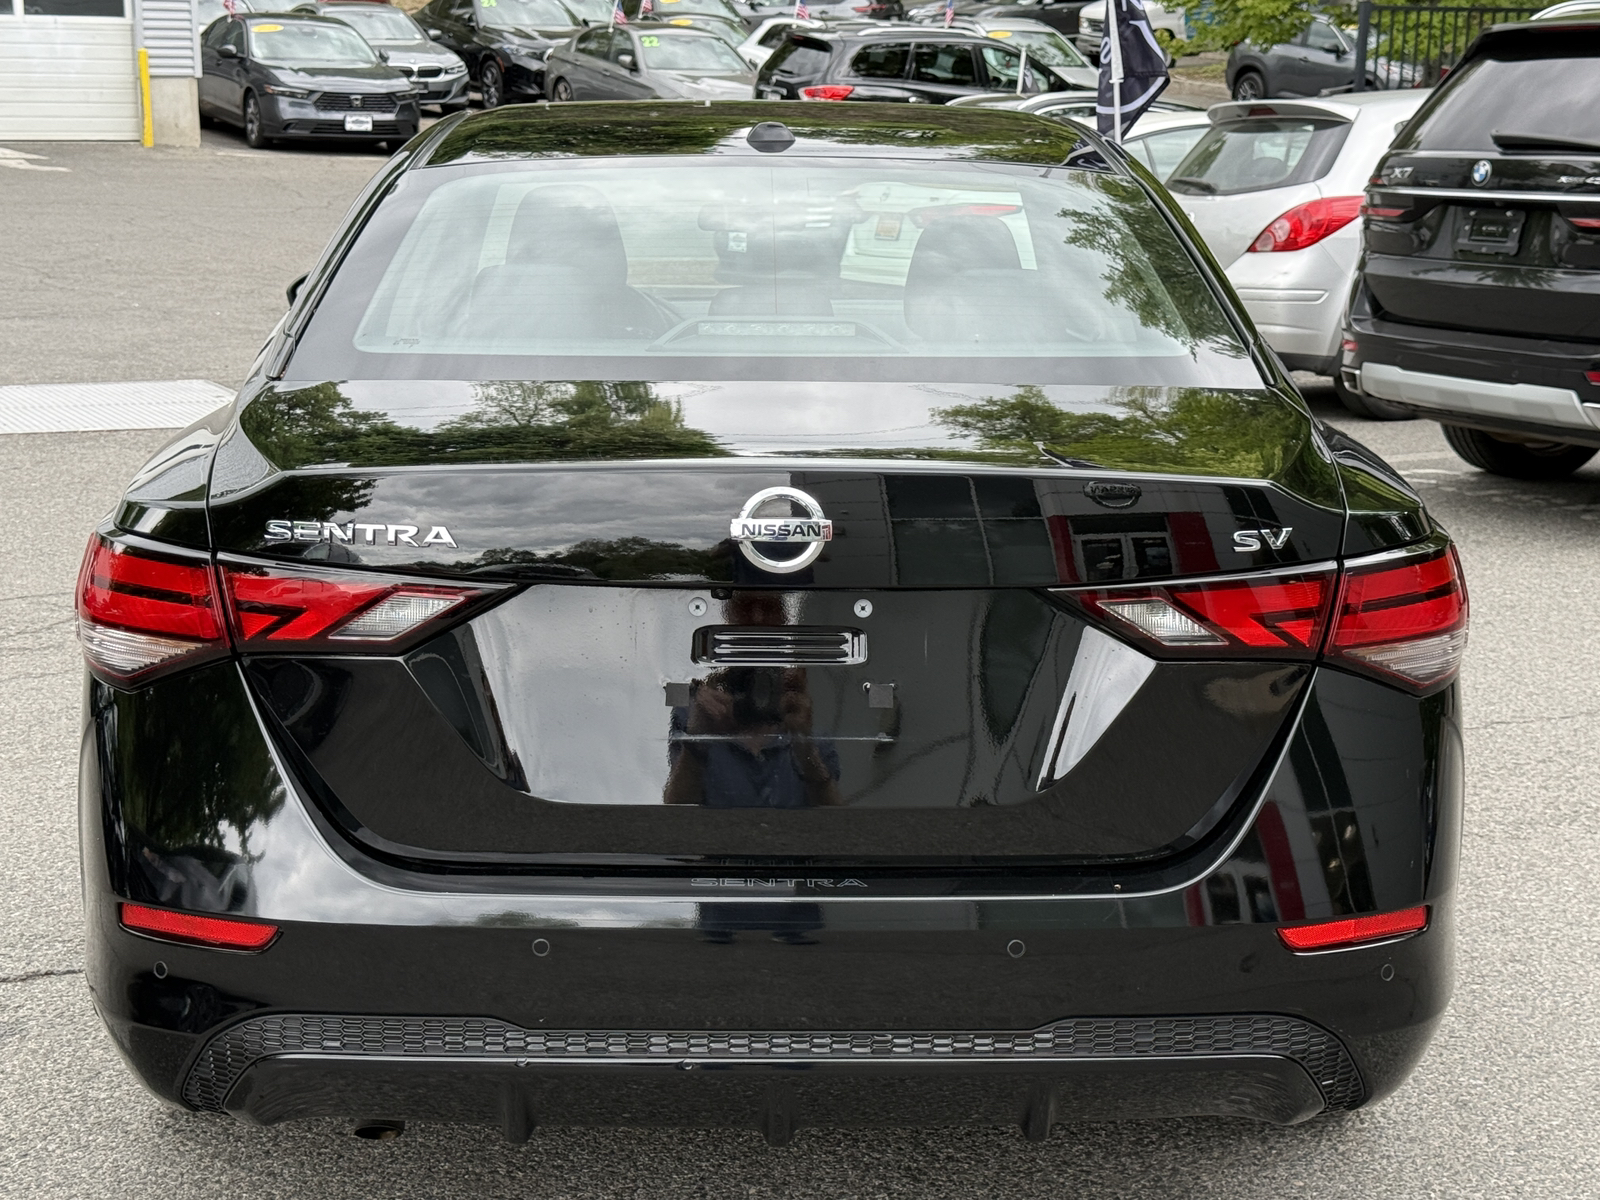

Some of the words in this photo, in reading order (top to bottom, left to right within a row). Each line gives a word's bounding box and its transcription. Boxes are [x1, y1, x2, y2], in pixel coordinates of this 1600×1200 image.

[640, 35, 660, 48] 22
[1390, 166, 1415, 179] X7
[263, 519, 459, 549] SENTRA
[741, 523, 821, 537] NISSAN
[1232, 527, 1293, 552] SV
[690, 877, 868, 888] SENTRA
